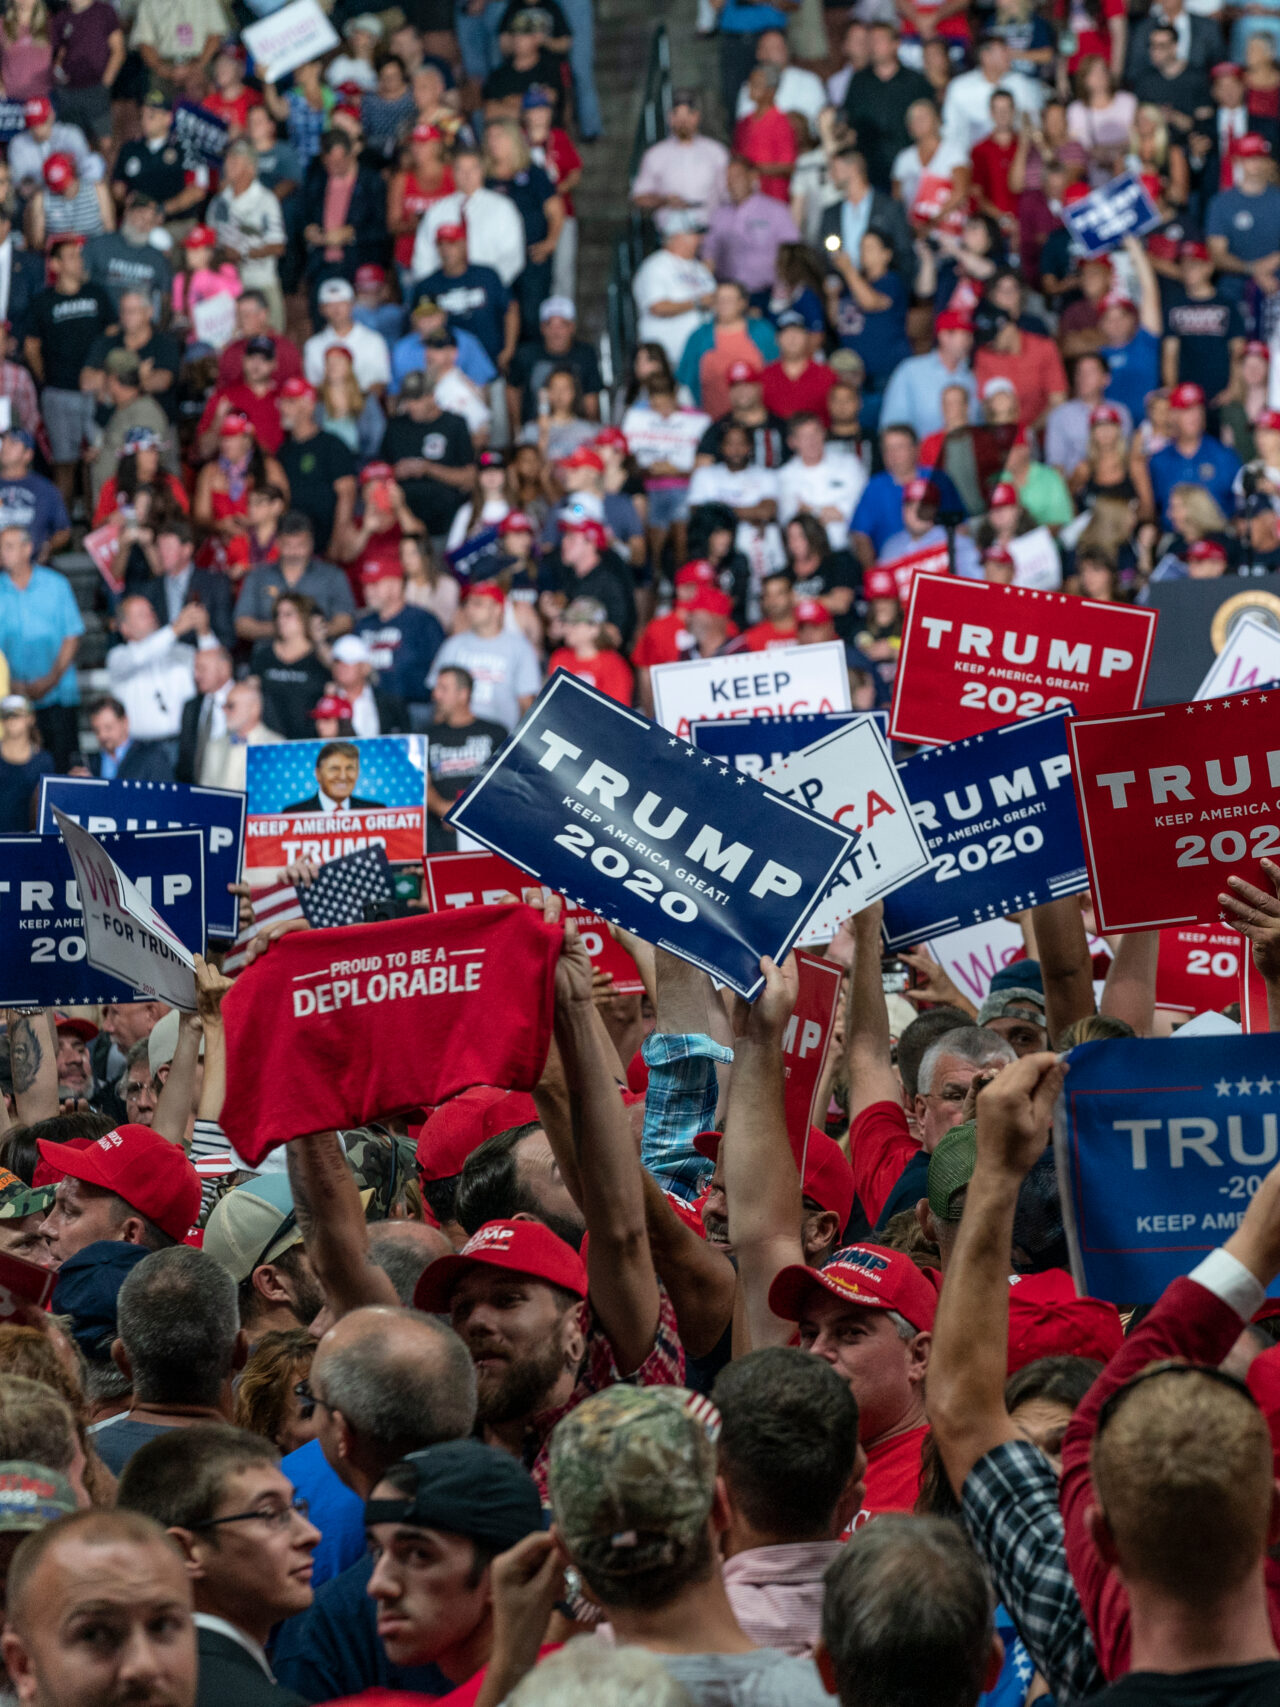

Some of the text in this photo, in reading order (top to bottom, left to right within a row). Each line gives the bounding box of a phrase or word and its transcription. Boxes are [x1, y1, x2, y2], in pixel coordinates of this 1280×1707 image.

[921, 616, 1134, 679] TRUMP
[710, 671, 791, 703] KEEP
[954, 661, 1090, 692] KEEP AMERICA GREAT!
[910, 755, 1072, 830] RUMP
[248, 820, 289, 837] KEEP
[292, 816, 362, 836] AMERICA
[365, 813, 421, 831] GREAT!
[538, 729, 802, 900] TRUMP
[947, 818, 1001, 844] AMERICA
[1003, 802, 1047, 824] GREAT!
[1155, 812, 1195, 827] KEEP
[1200, 801, 1271, 821] AMERICA
[562, 796, 731, 906] KEEP AMERICA GREAT!
[930, 825, 1045, 883] 2020
[553, 823, 699, 923] 2020
[19, 919, 50, 930] KEEP
[103, 912, 135, 943] FOR
[138, 929, 187, 969] TRUM
[1178, 932, 1206, 943] KEEP
[30, 936, 86, 963] 20
[330, 947, 447, 978] PROUD TO BE A
[1186, 950, 1238, 978] 20
[293, 962, 483, 1018] DEPLORABLE
[1136, 1214, 1196, 1234] KEEP
